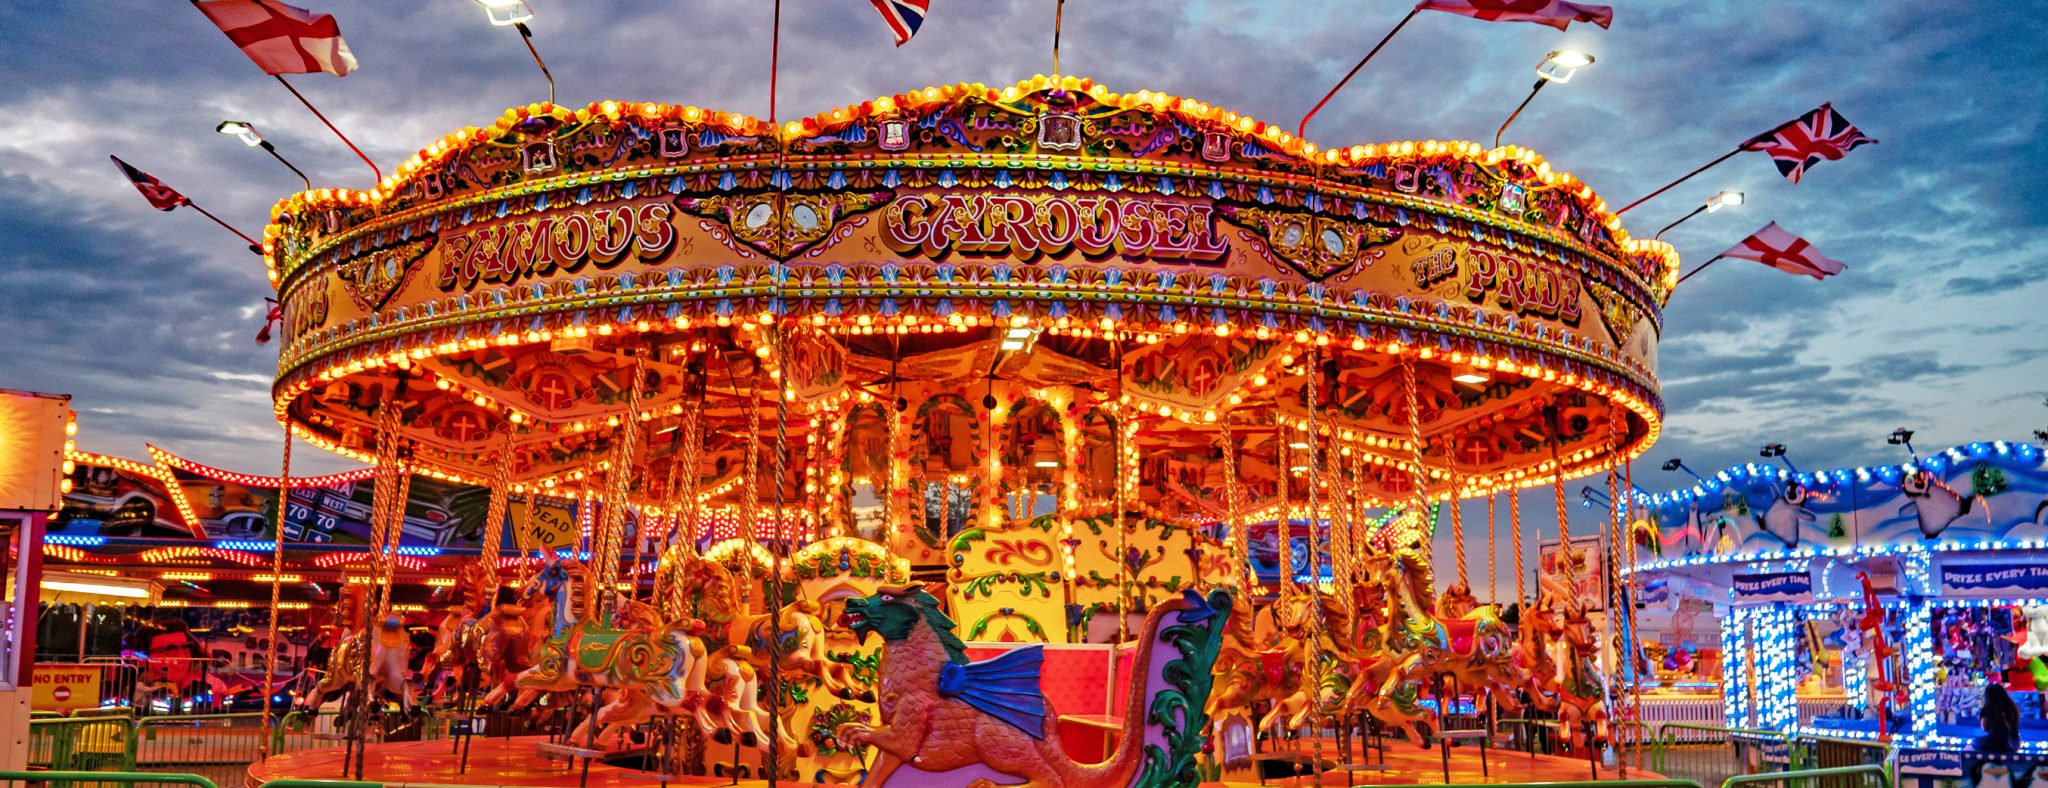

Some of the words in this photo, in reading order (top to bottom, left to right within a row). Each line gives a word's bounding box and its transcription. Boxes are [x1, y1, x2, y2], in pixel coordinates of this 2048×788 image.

[438, 203, 675, 290] FAMOUS
[882, 195, 1230, 262] CAROUSEL
[1411, 247, 1457, 287] THE
[1463, 247, 1582, 325] PRIDE
[295, 487, 317, 499] EAST
[323, 496, 345, 511] WEST
[289, 504, 308, 520] 70
[532, 505, 570, 532] DEAD
[317, 514, 336, 529] 70
[520, 521, 555, 544] ND
[1735, 581, 1760, 591] PRIZE
[1761, 577, 1787, 589] EVERY
[1789, 575, 1809, 585] TIME
[1944, 572, 1982, 583] PRIZE
[1985, 568, 2026, 582] EVERY
[2030, 567, 2048, 577] TIM
[33, 674, 51, 684] NO
[54, 674, 93, 684] ENTRY
[1911, 753, 1938, 763] EVERY
[1939, 752, 1960, 762] TIME
